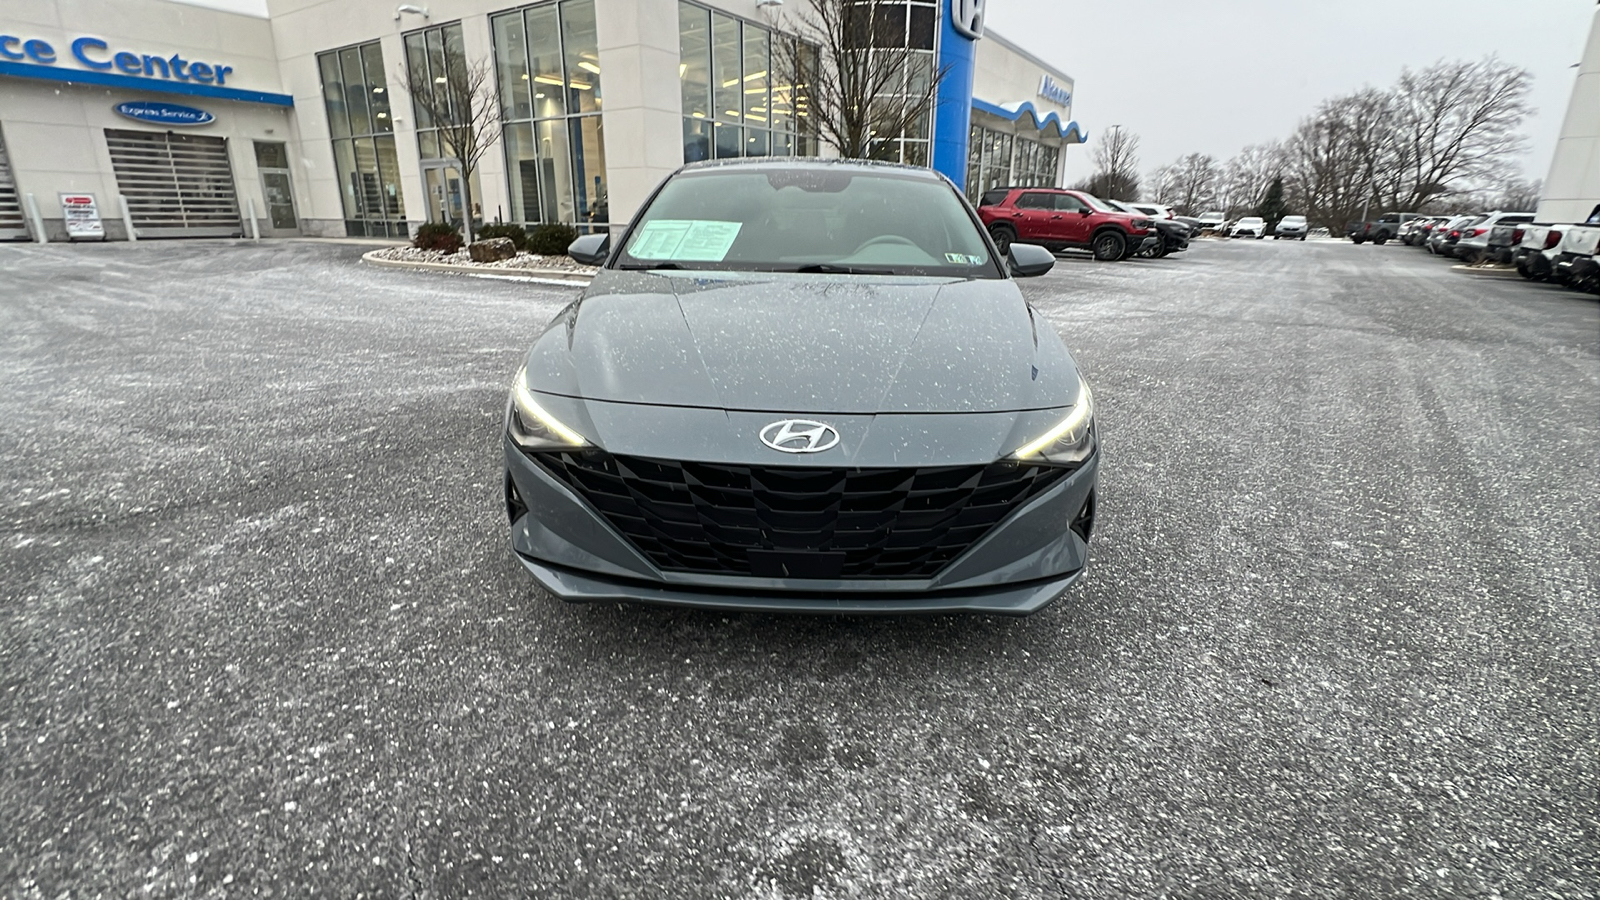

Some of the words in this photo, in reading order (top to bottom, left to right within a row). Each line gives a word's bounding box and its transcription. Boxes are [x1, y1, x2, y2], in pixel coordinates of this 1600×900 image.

[71, 37, 233, 85] Center
[121, 105, 160, 116] Express
[161, 108, 196, 119] Service
